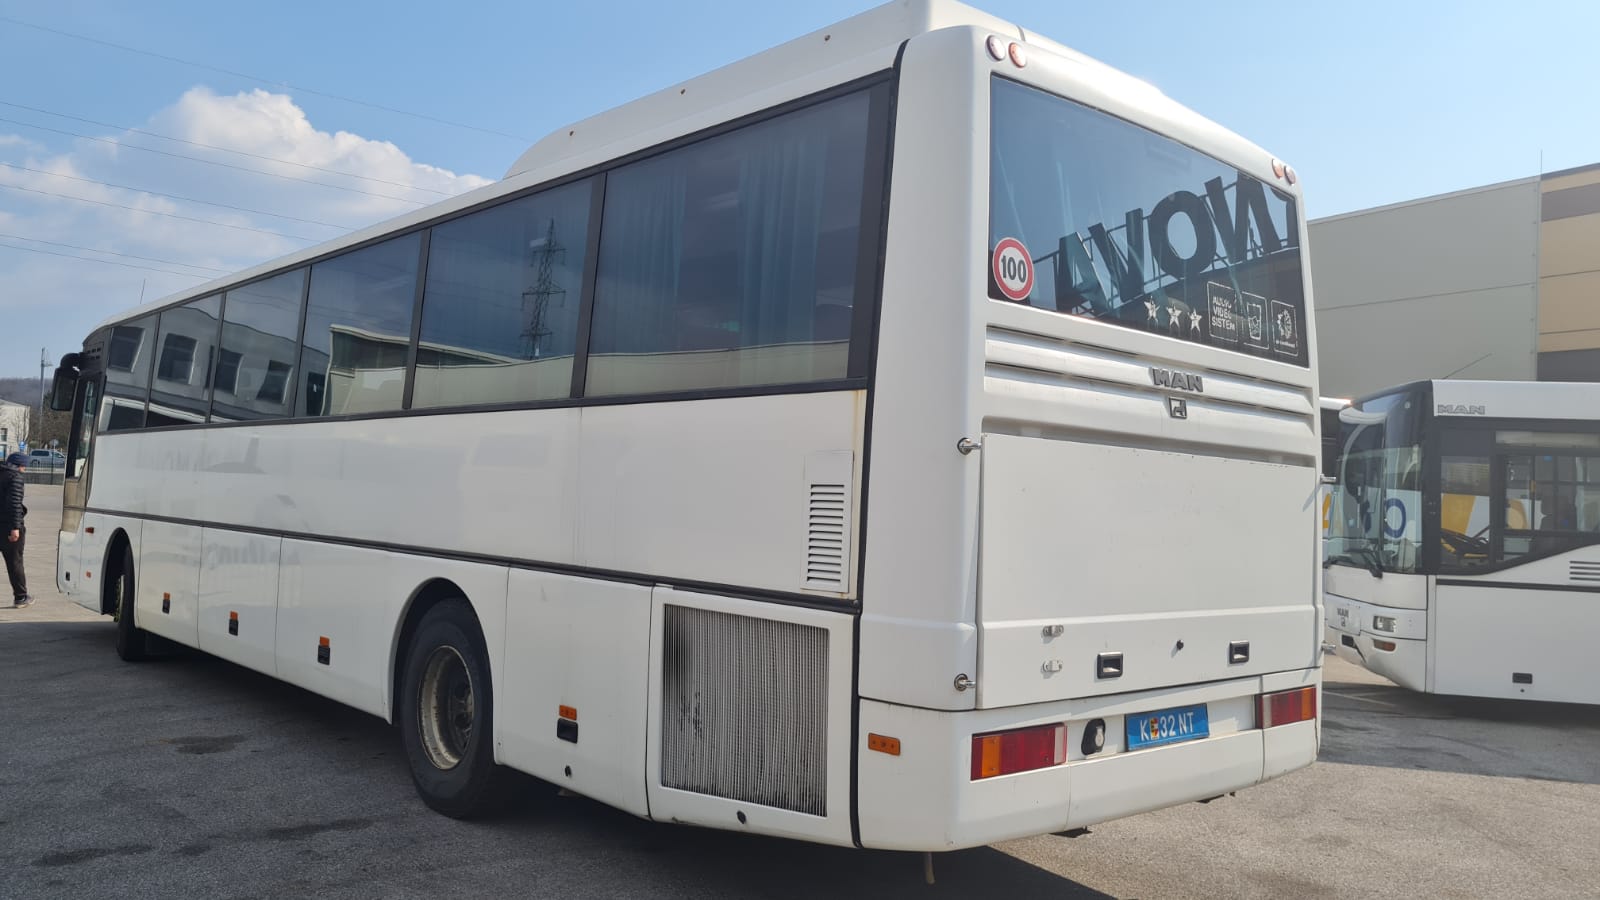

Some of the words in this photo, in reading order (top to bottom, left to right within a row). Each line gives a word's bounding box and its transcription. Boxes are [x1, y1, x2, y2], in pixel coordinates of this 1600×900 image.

[1001, 255, 1026, 283] 100
[1212, 316, 1235, 331] SISTEM
[1152, 368, 1203, 392] MAN
[1437, 403, 1486, 415] MAN
[1140, 719, 1149, 742] K
